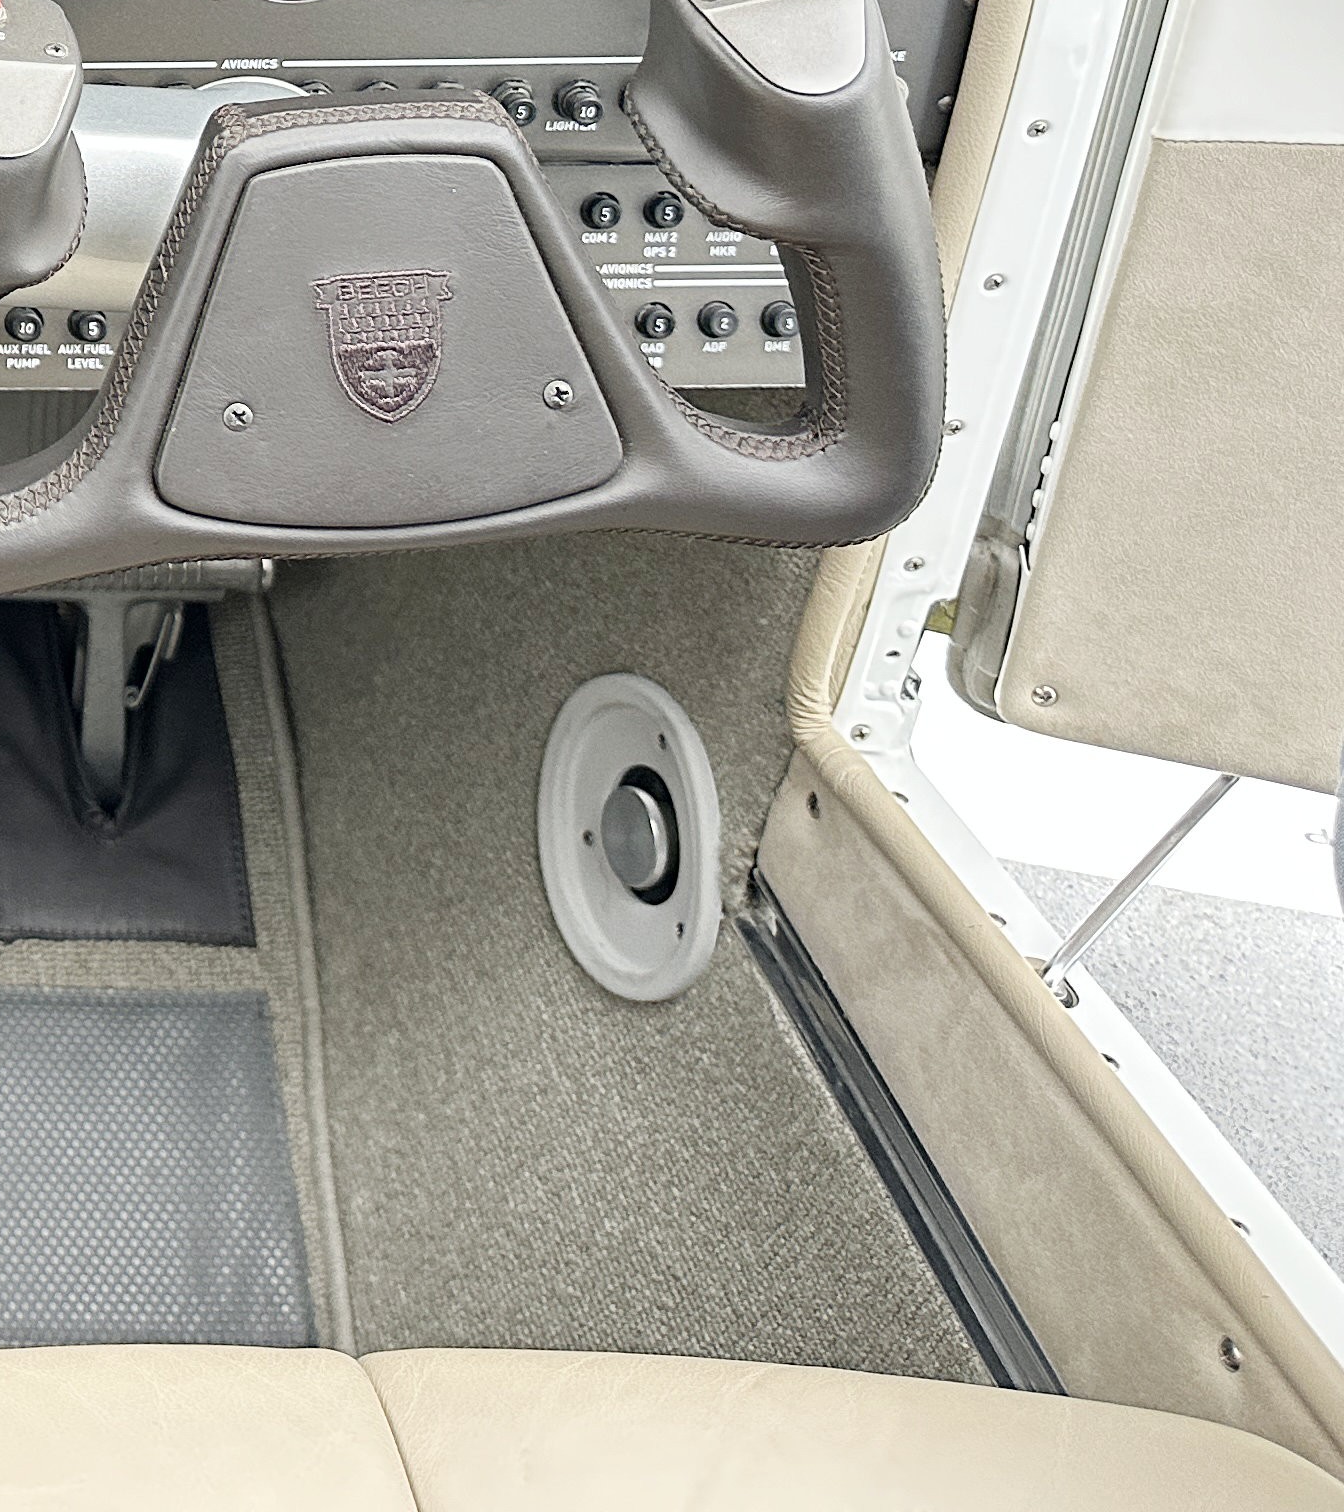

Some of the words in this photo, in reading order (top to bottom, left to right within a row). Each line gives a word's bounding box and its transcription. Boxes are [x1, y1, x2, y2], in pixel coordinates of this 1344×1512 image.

[221, 58, 278, 70] AVIONICS
[582, 233, 605, 243] COM
[609, 233, 616, 242] 2
[644, 232, 667, 242] NAV
[669, 232, 677, 242] 2
[644, 247, 665, 257] GPS
[668, 247, 676, 257] 2
[710, 246, 736, 256] MKR
[22, 344, 50, 355] FUEL
[58, 344, 82, 355] AUX
[84, 344, 113, 355] FUEL
[703, 342, 726, 352] ADF
[765, 341, 789, 351] DME
[7, 358, 40, 368] PUMP
[68, 358, 103, 368] LEVEL
